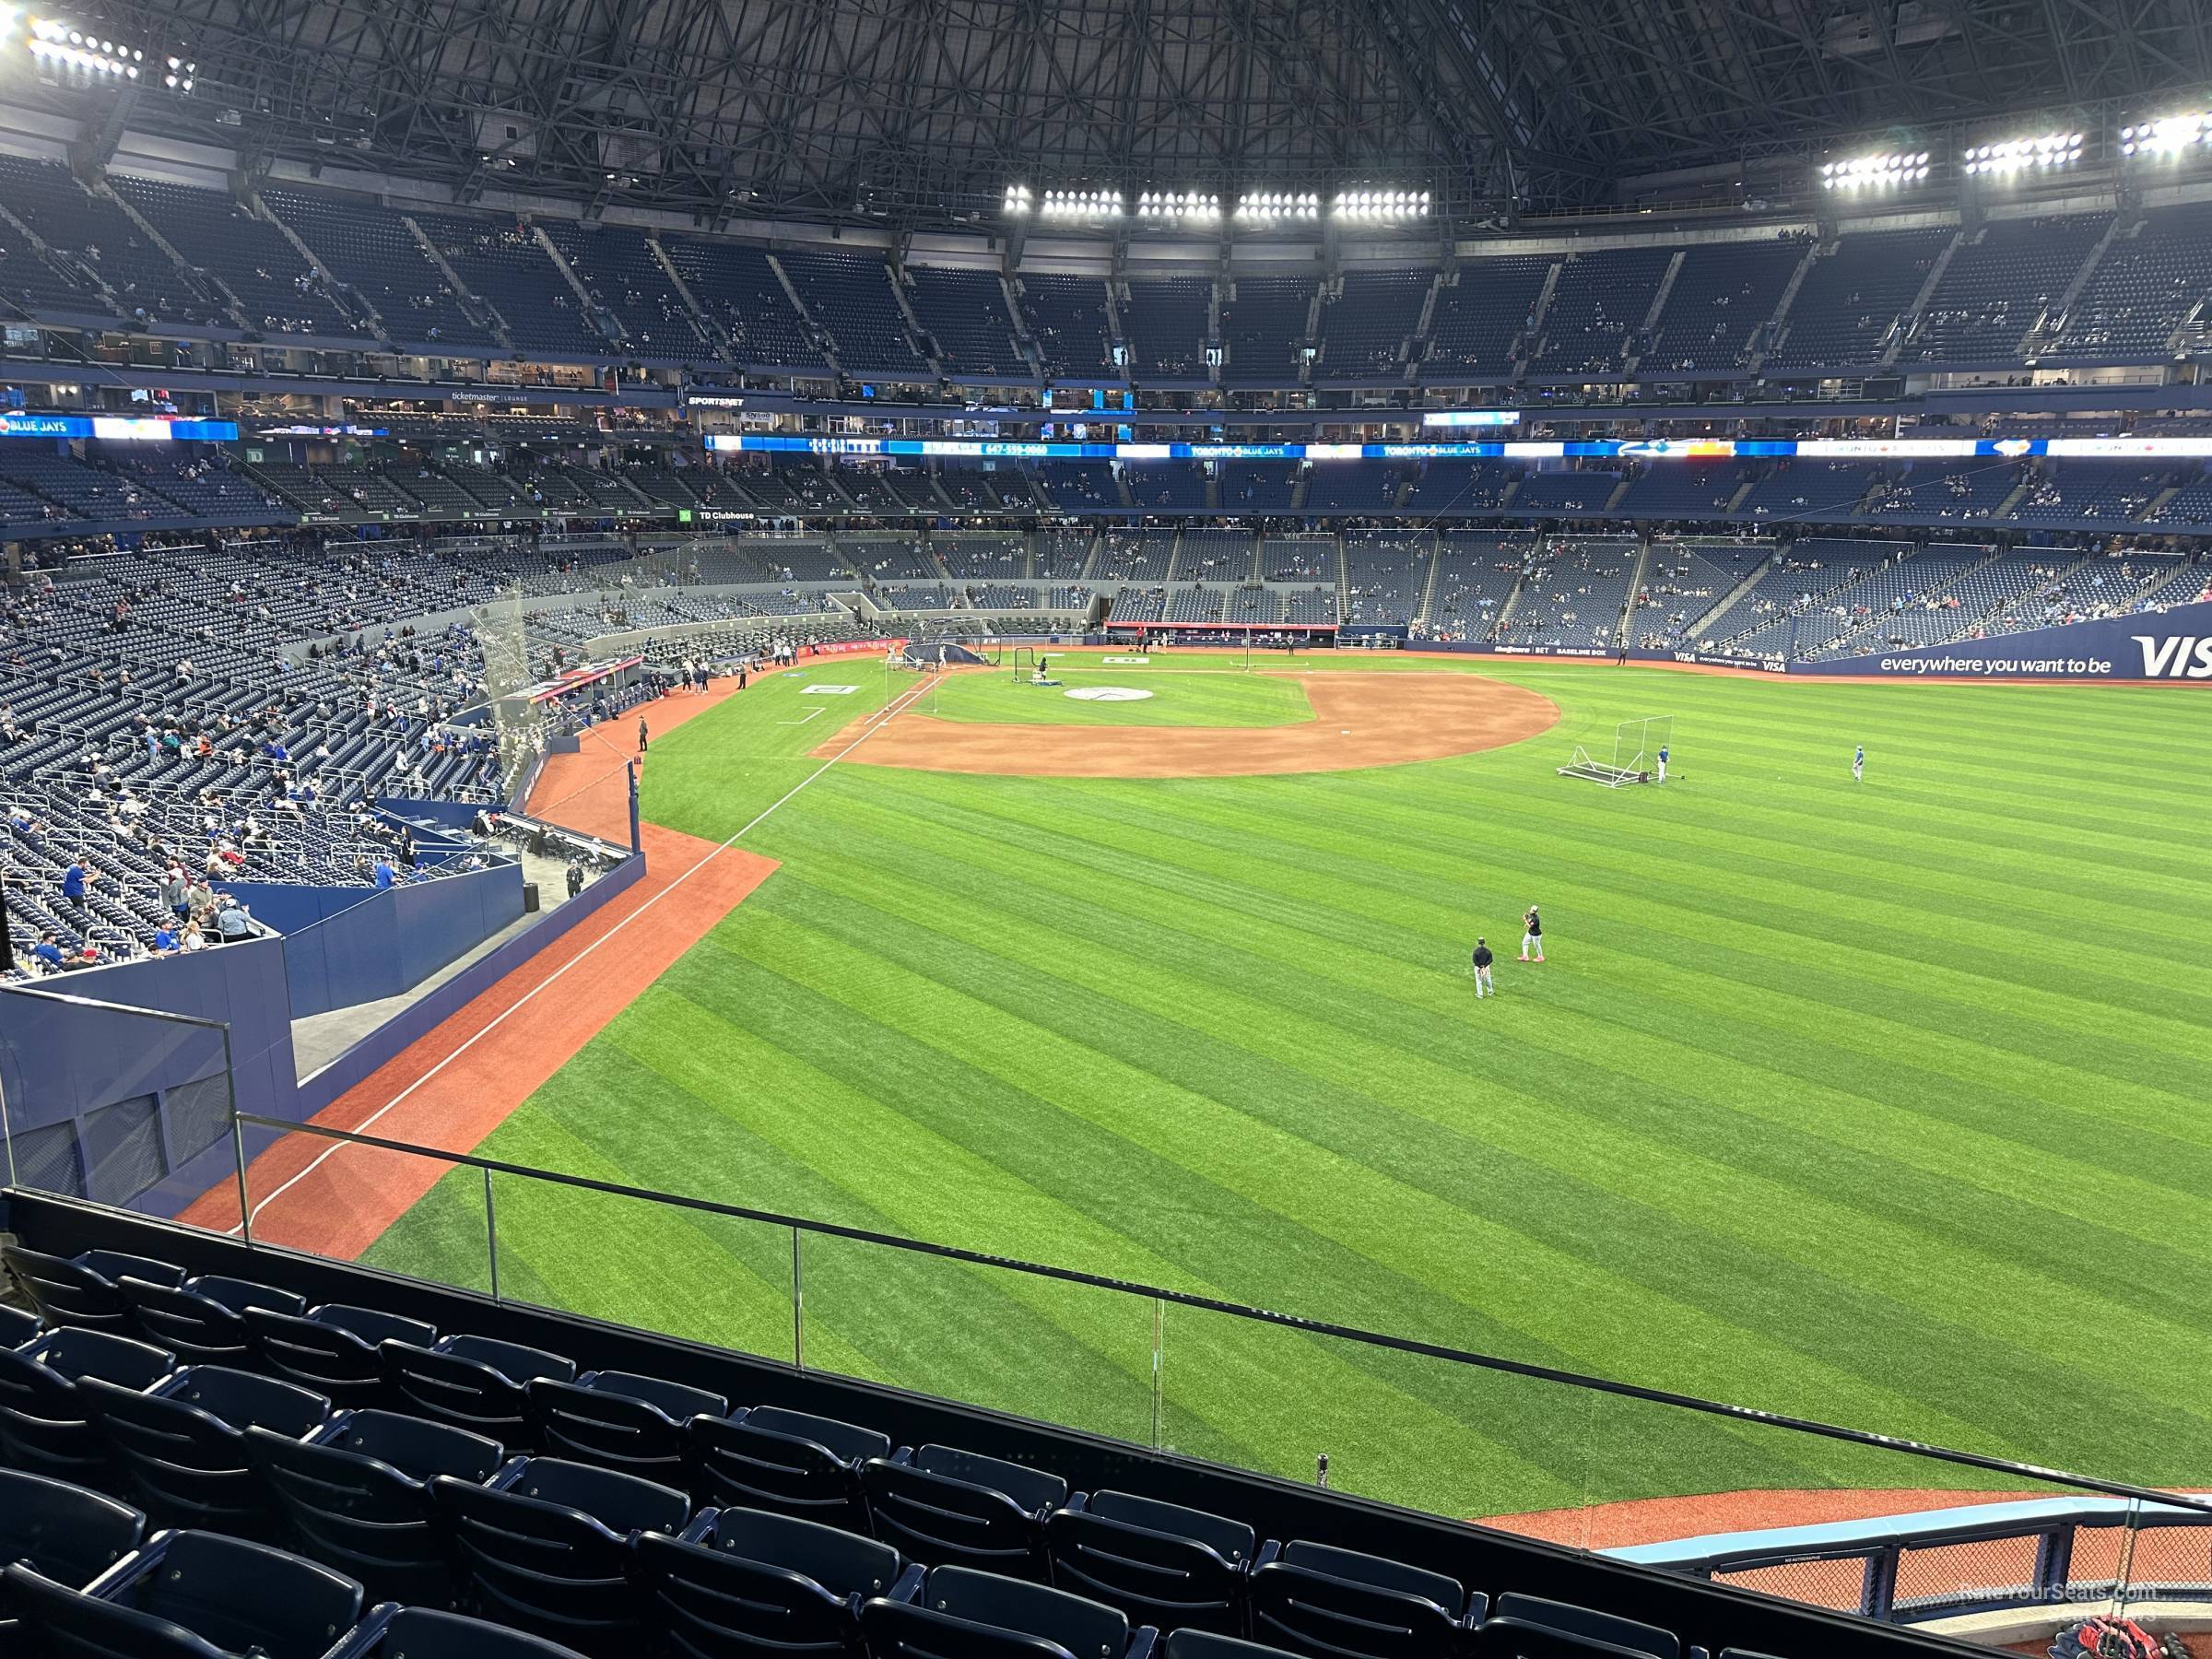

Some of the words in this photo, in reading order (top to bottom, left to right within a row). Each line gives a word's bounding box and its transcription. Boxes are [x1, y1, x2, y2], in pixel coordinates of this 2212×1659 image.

[452, 392, 496, 401] ticketmaster
[688, 396, 744, 406] SPORTSNET
[9, 420, 39, 431] BLUE
[40, 420, 67, 432] JAYS
[1192, 447, 1233, 457] TORONTO
[1384, 446, 1428, 456] TORONTO
[1459, 446, 1481, 454] JAYS
[248, 451, 263, 462] TD
[700, 512, 712, 520] TD
[712, 512, 754, 520] Clubhouse
[1674, 652, 1696, 663] VISA
[1762, 661, 1785, 673] VISA
[1880, 655, 1983, 674] everywhere
[1983, 659, 2018, 675] you
[2020, 658, 2064, 673] want
[2066, 658, 2086, 673] to
[2088, 657, 2112, 673] be
